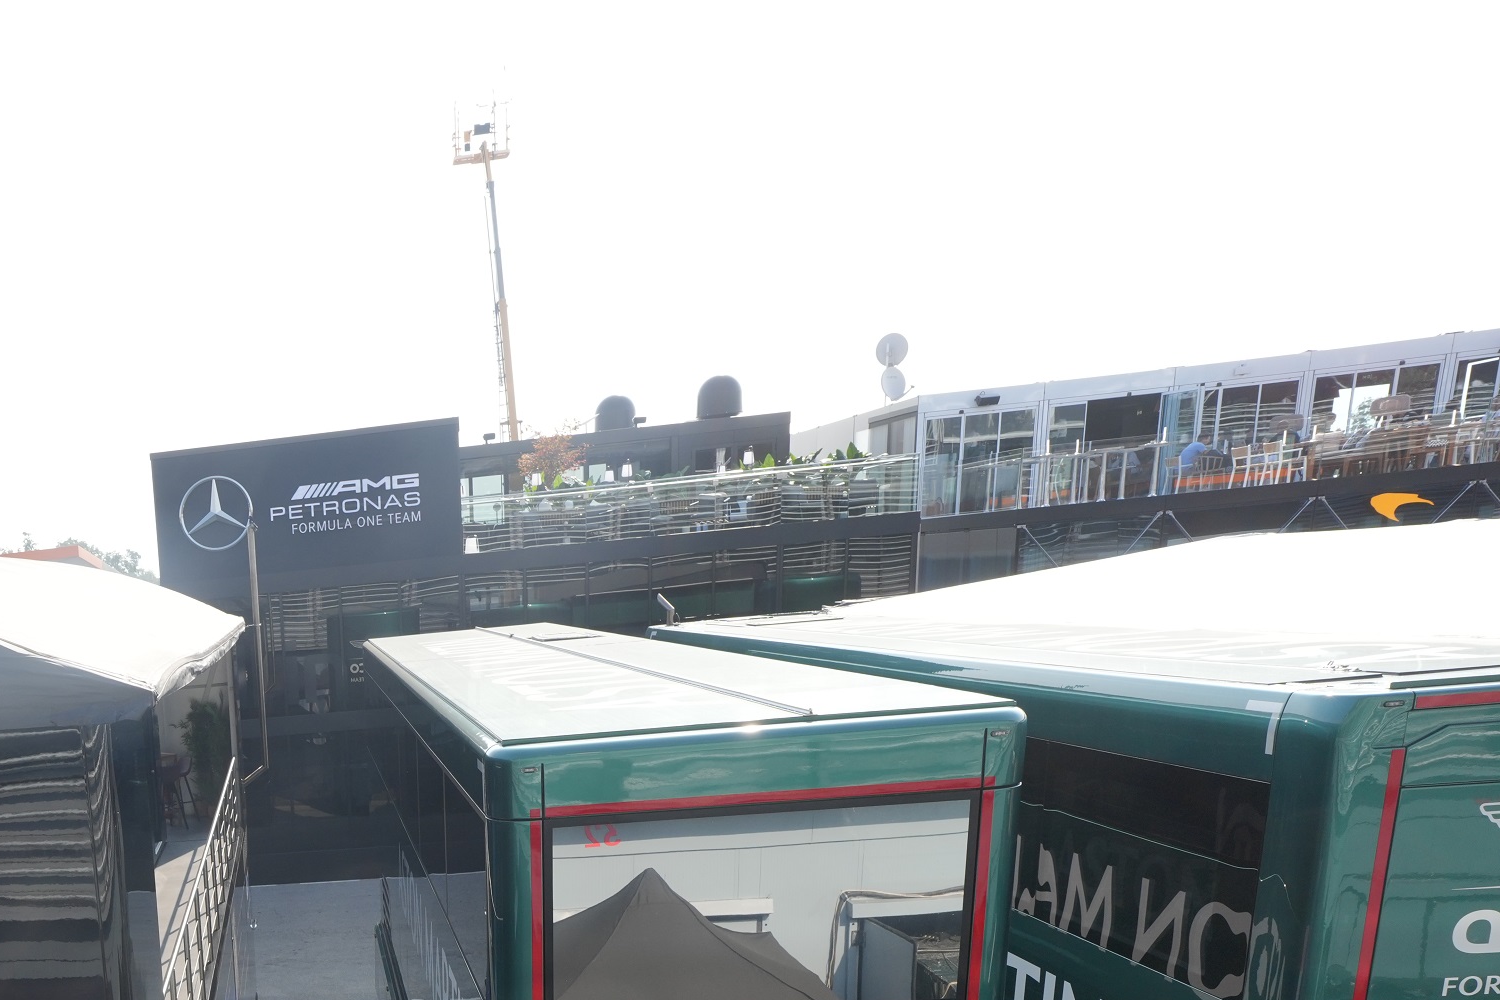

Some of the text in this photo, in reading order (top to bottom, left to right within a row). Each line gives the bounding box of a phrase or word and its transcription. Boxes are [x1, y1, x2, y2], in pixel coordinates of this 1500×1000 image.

[331, 473, 420, 496] AMG
[269, 491, 421, 522] PETRONAS
[291, 510, 421, 535] FORMULA ONE TEAM
